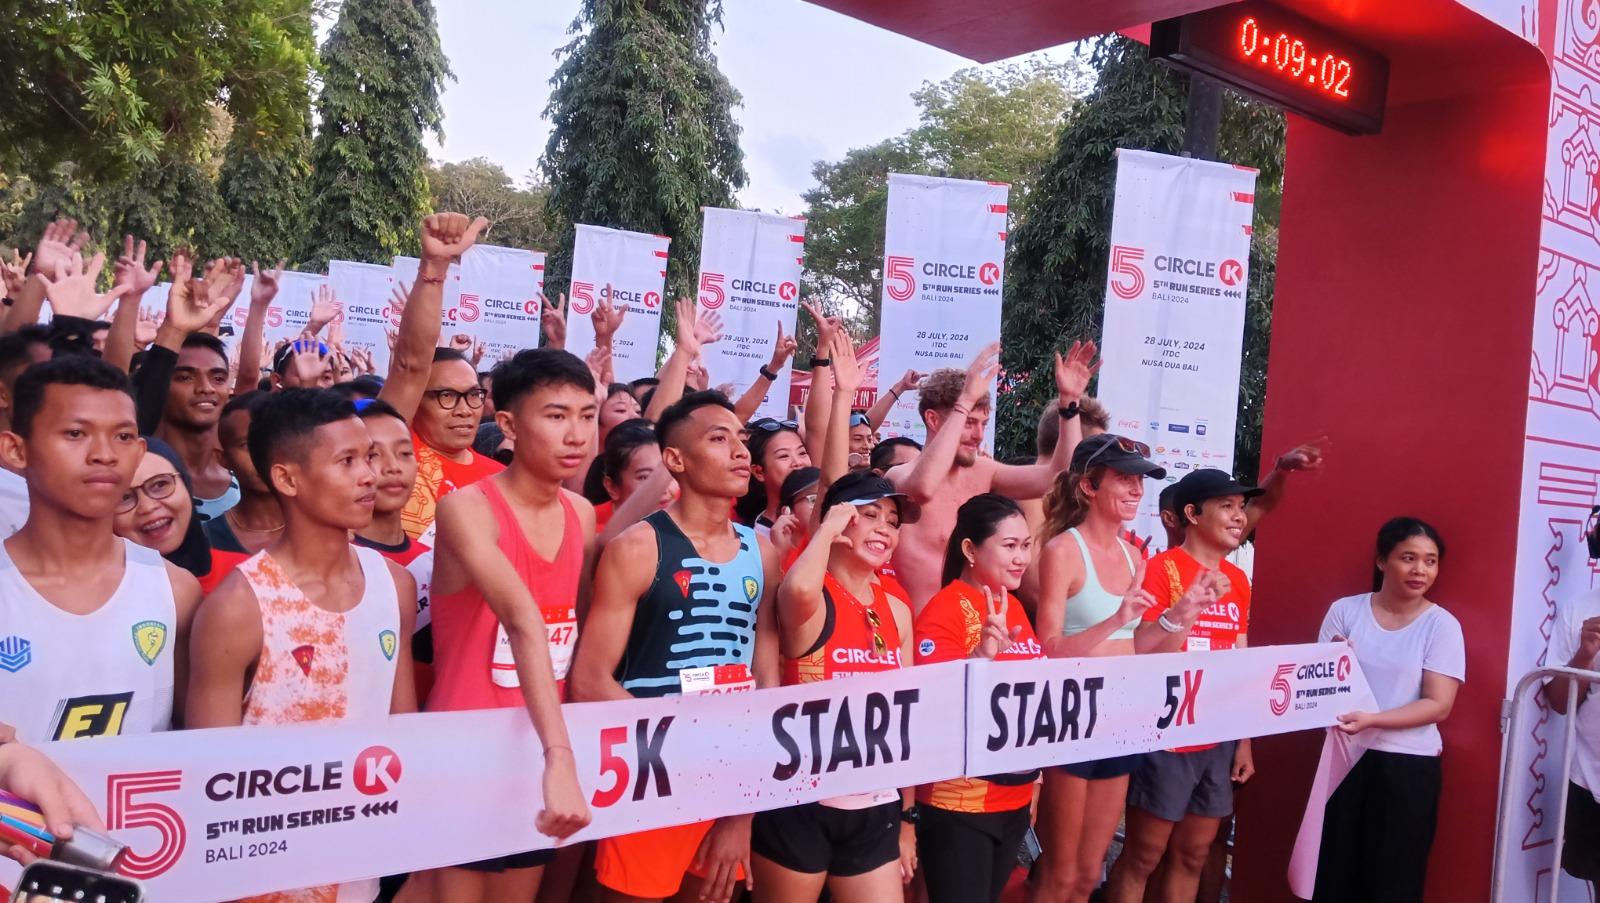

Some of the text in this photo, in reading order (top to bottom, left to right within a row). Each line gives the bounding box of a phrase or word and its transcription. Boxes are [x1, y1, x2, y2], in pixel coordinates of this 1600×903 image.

[1241, 18, 1351, 97] 0:09:02
[887, 256, 915, 301] 5
[922, 262, 999, 285] CIRCLE K
[1111, 245, 1145, 299] 5
[1154, 255, 1243, 286] CIRCLE K
[572, 281, 594, 314] 5
[600, 288, 659, 308] CRCLE K
[700, 272, 725, 310] 5
[731, 279, 796, 300] CIRCLE K
[922, 283, 981, 295] 5TH RUN SERIES
[938, 295, 954, 303] 2024
[1152, 292, 1189, 304] BALI 2024
[1153, 280, 1221, 297] 5TH RUN SERIES
[349, 305, 380, 315] CIRCLE
[460, 294, 480, 322] 5
[485, 299, 538, 315] CIRCLE K
[742, 296, 756, 304] RUN
[756, 299, 780, 308] SERIES
[267, 306, 282, 327] 5
[286, 310, 309, 318] CIRCL
[916, 331, 969, 342] 28 JULY, 2024
[1144, 336, 1205, 351] 28 JULY, 2024
[1162, 350, 1180, 358] ITDC
[1141, 359, 1199, 372] NUSA DUA BALI
[832, 648, 896, 665] CIRCLE
[1297, 656, 1350, 681] CIRCLE K
[1270, 664, 1296, 716] 5
[1306, 689, 1318, 698] RUN
[1318, 687, 1336, 697] SERIES
[986, 676, 1104, 752] START
[591, 688, 920, 808] 5K START
[204, 747, 402, 802] CIRCLE K
[107, 770, 187, 880] 5
[206, 805, 356, 840] 5TH RUN SERIES
[205, 840, 288, 863] BALI 2024
